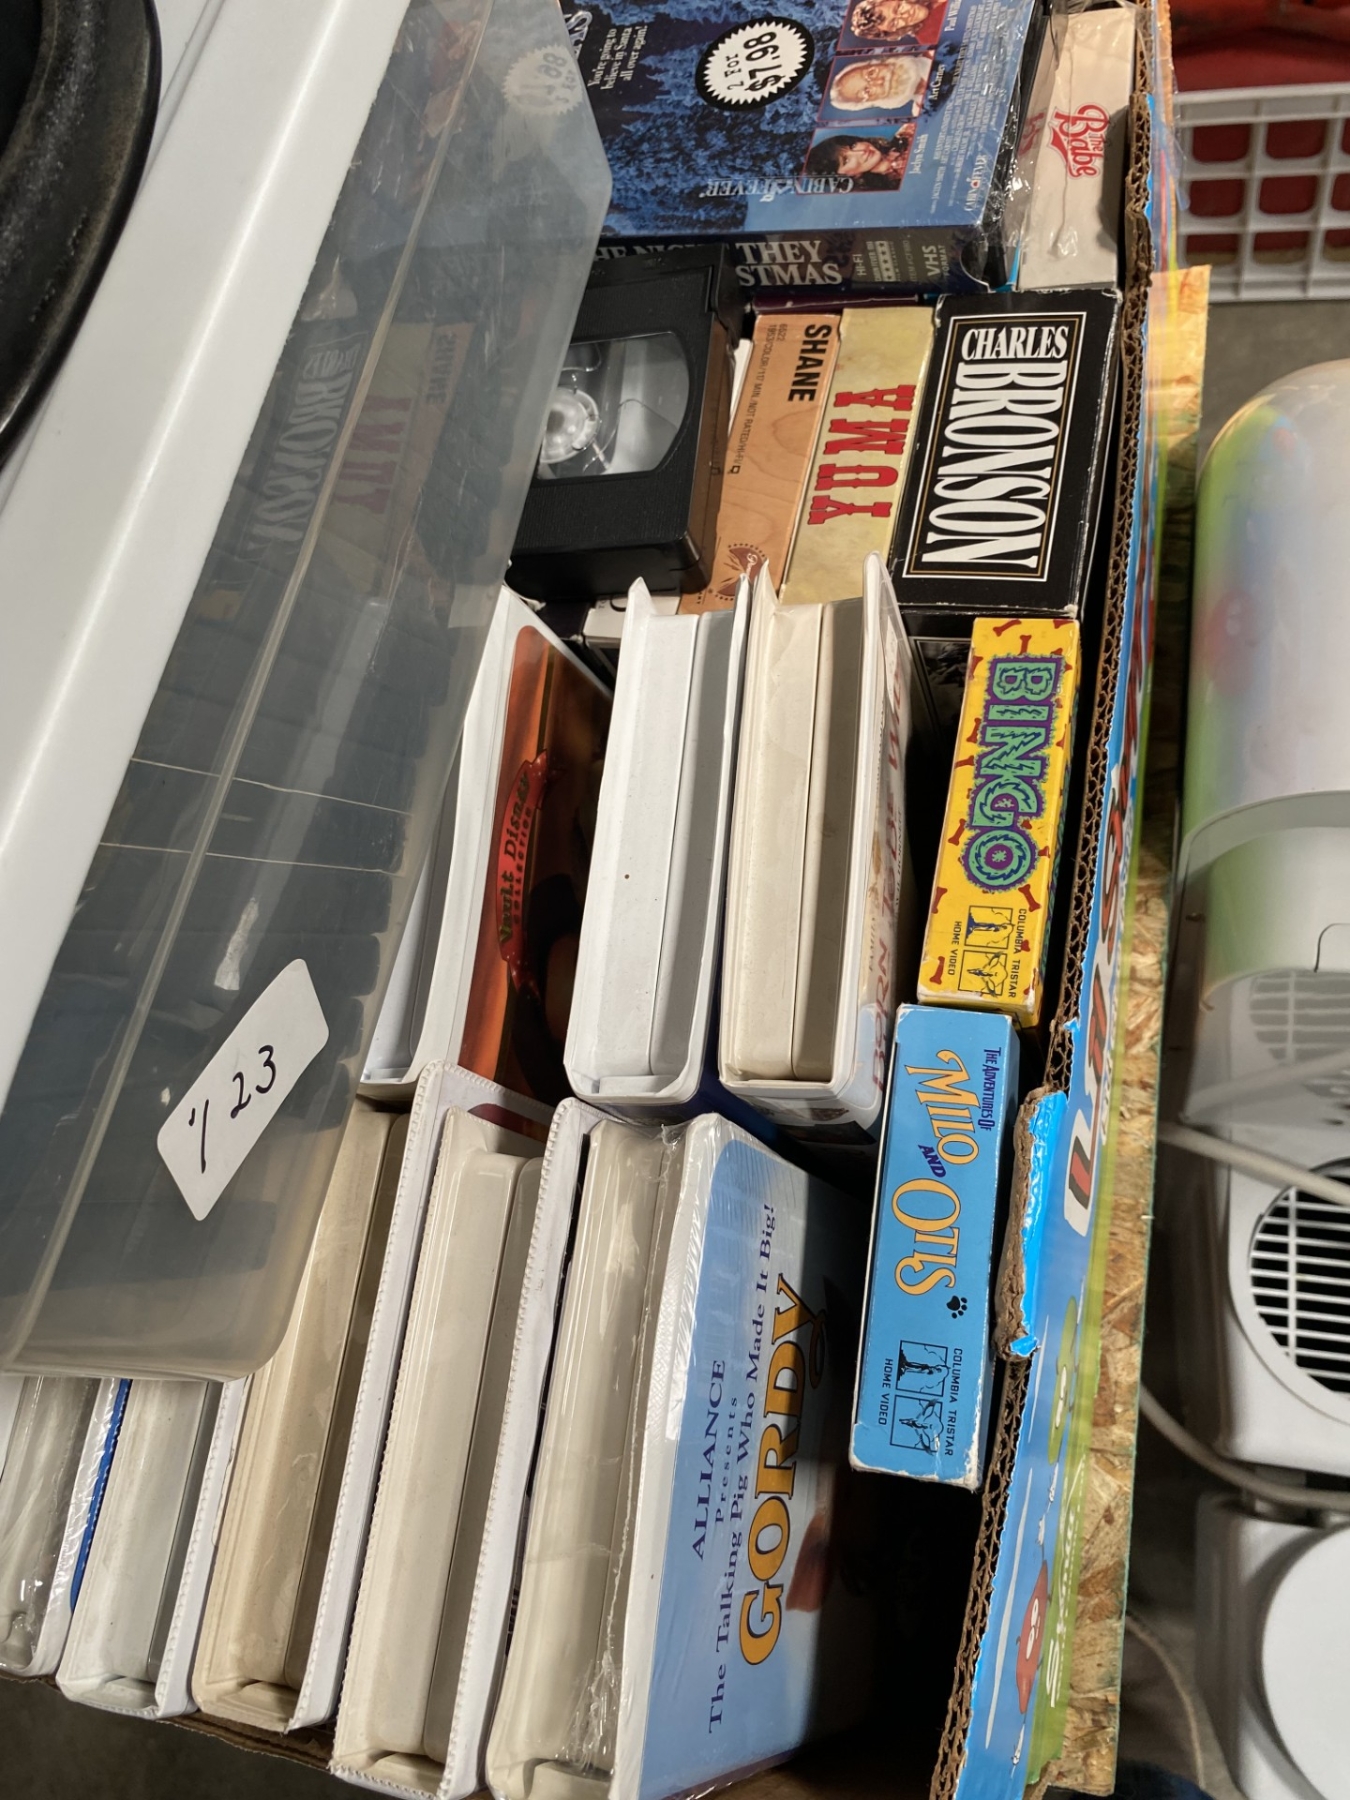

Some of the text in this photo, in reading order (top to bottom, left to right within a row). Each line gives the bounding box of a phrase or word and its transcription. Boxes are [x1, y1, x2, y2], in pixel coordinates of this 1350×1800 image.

[944, 0, 962, 31] Paul Willi
[587, 27, 617, 86] You're going to
[600, 26, 633, 89] believe in Santa
[620, 25, 648, 80] all over again!
[725, 54, 744, 89] 2 For
[742, 32, 786, 91] $7.98
[931, 63, 946, 87] Carney
[929, 86, 940, 100] Art
[910, 134, 929, 174] Jaclyn Smith
[1054, 105, 1110, 177] The Babe
[708, 178, 854, 197] CABIN FEVER
[735, 240, 825, 264] THEY
[735, 262, 842, 287] STMAS
[853, 254, 867, 276] HI-FI
[922, 246, 940, 275] VHS
[939, 245, 950, 275] FORMAT
[788, 325, 832, 401] SHANE
[962, 326, 1067, 359] CHARLES
[807, 386, 916, 524] YUMA
[922, 360, 1068, 567] BRONSON
[965, 662, 1057, 884] BINGO
[503, 772, 528, 861] Disney
[513, 808, 531, 923] COLLECTION
[948, 921, 961, 975] HOME VIDEO
[1009, 909, 1026, 998] COLUMBIA TRISTAR
[918, 1145, 946, 1178] AND
[878, 1358, 893, 1425] HOME VIDEO
[945, 1348, 962, 1456] COLUMBIA TRISTAR
[696, 1360, 726, 1559] ALLIANCE
[708, 1204, 779, 1732] The Talking Pig Who Made It Big!
[715, 1396, 739, 1522] Presents
[737, 1273, 825, 1665] GORDY
